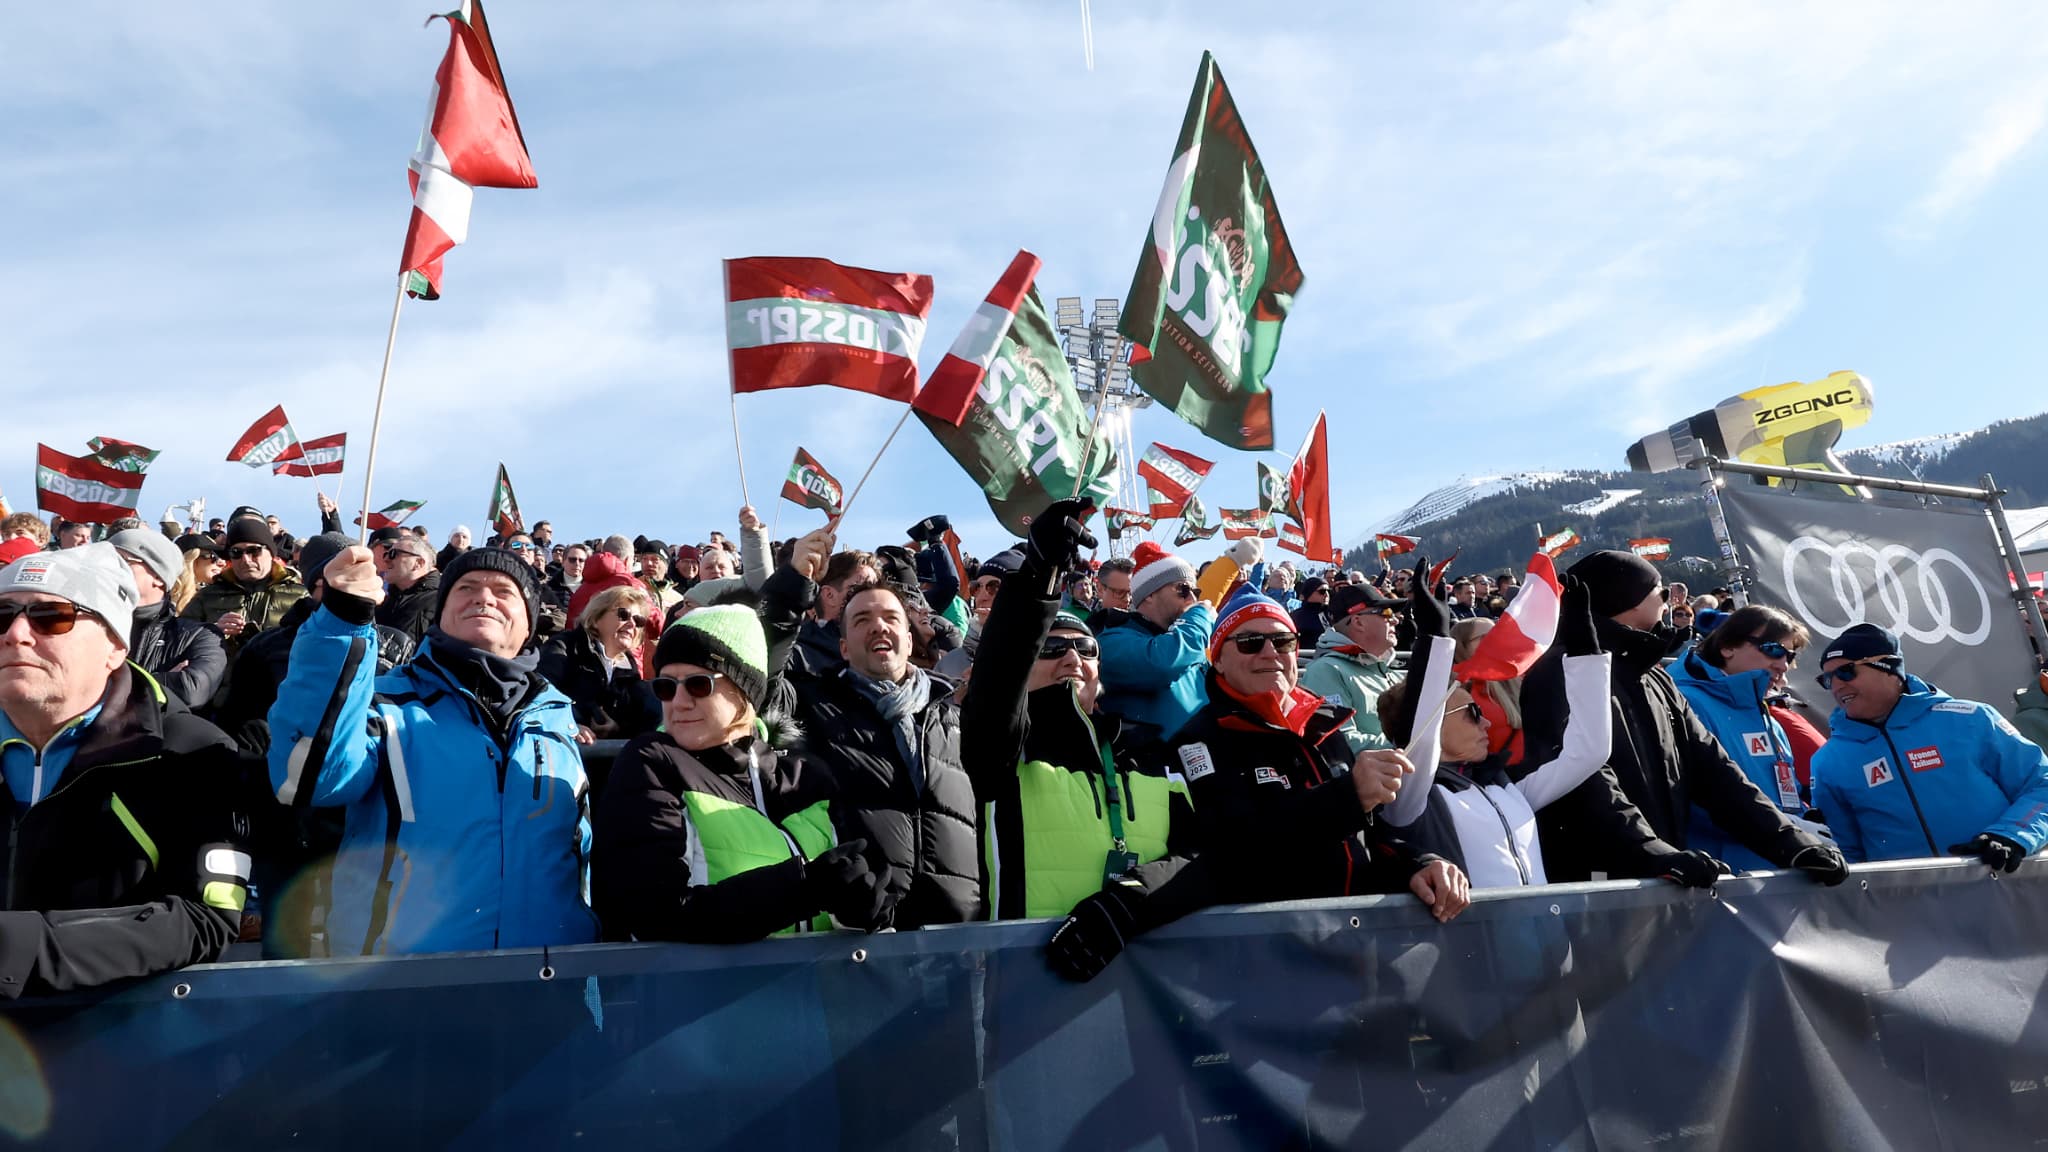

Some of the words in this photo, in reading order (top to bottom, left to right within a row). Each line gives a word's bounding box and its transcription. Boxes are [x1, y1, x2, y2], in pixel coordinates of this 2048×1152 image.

[1159, 318, 1195, 353] DITION
[1191, 350, 1215, 374] SEIT
[1755, 389, 1853, 424] ZGONC
[1751, 735, 1769, 753] A1
[1908, 749, 1938, 761] Kronen
[1912, 757, 1941, 769] Zeitung
[1190, 763, 1208, 777] 2025
[1870, 761, 1888, 784] A1
